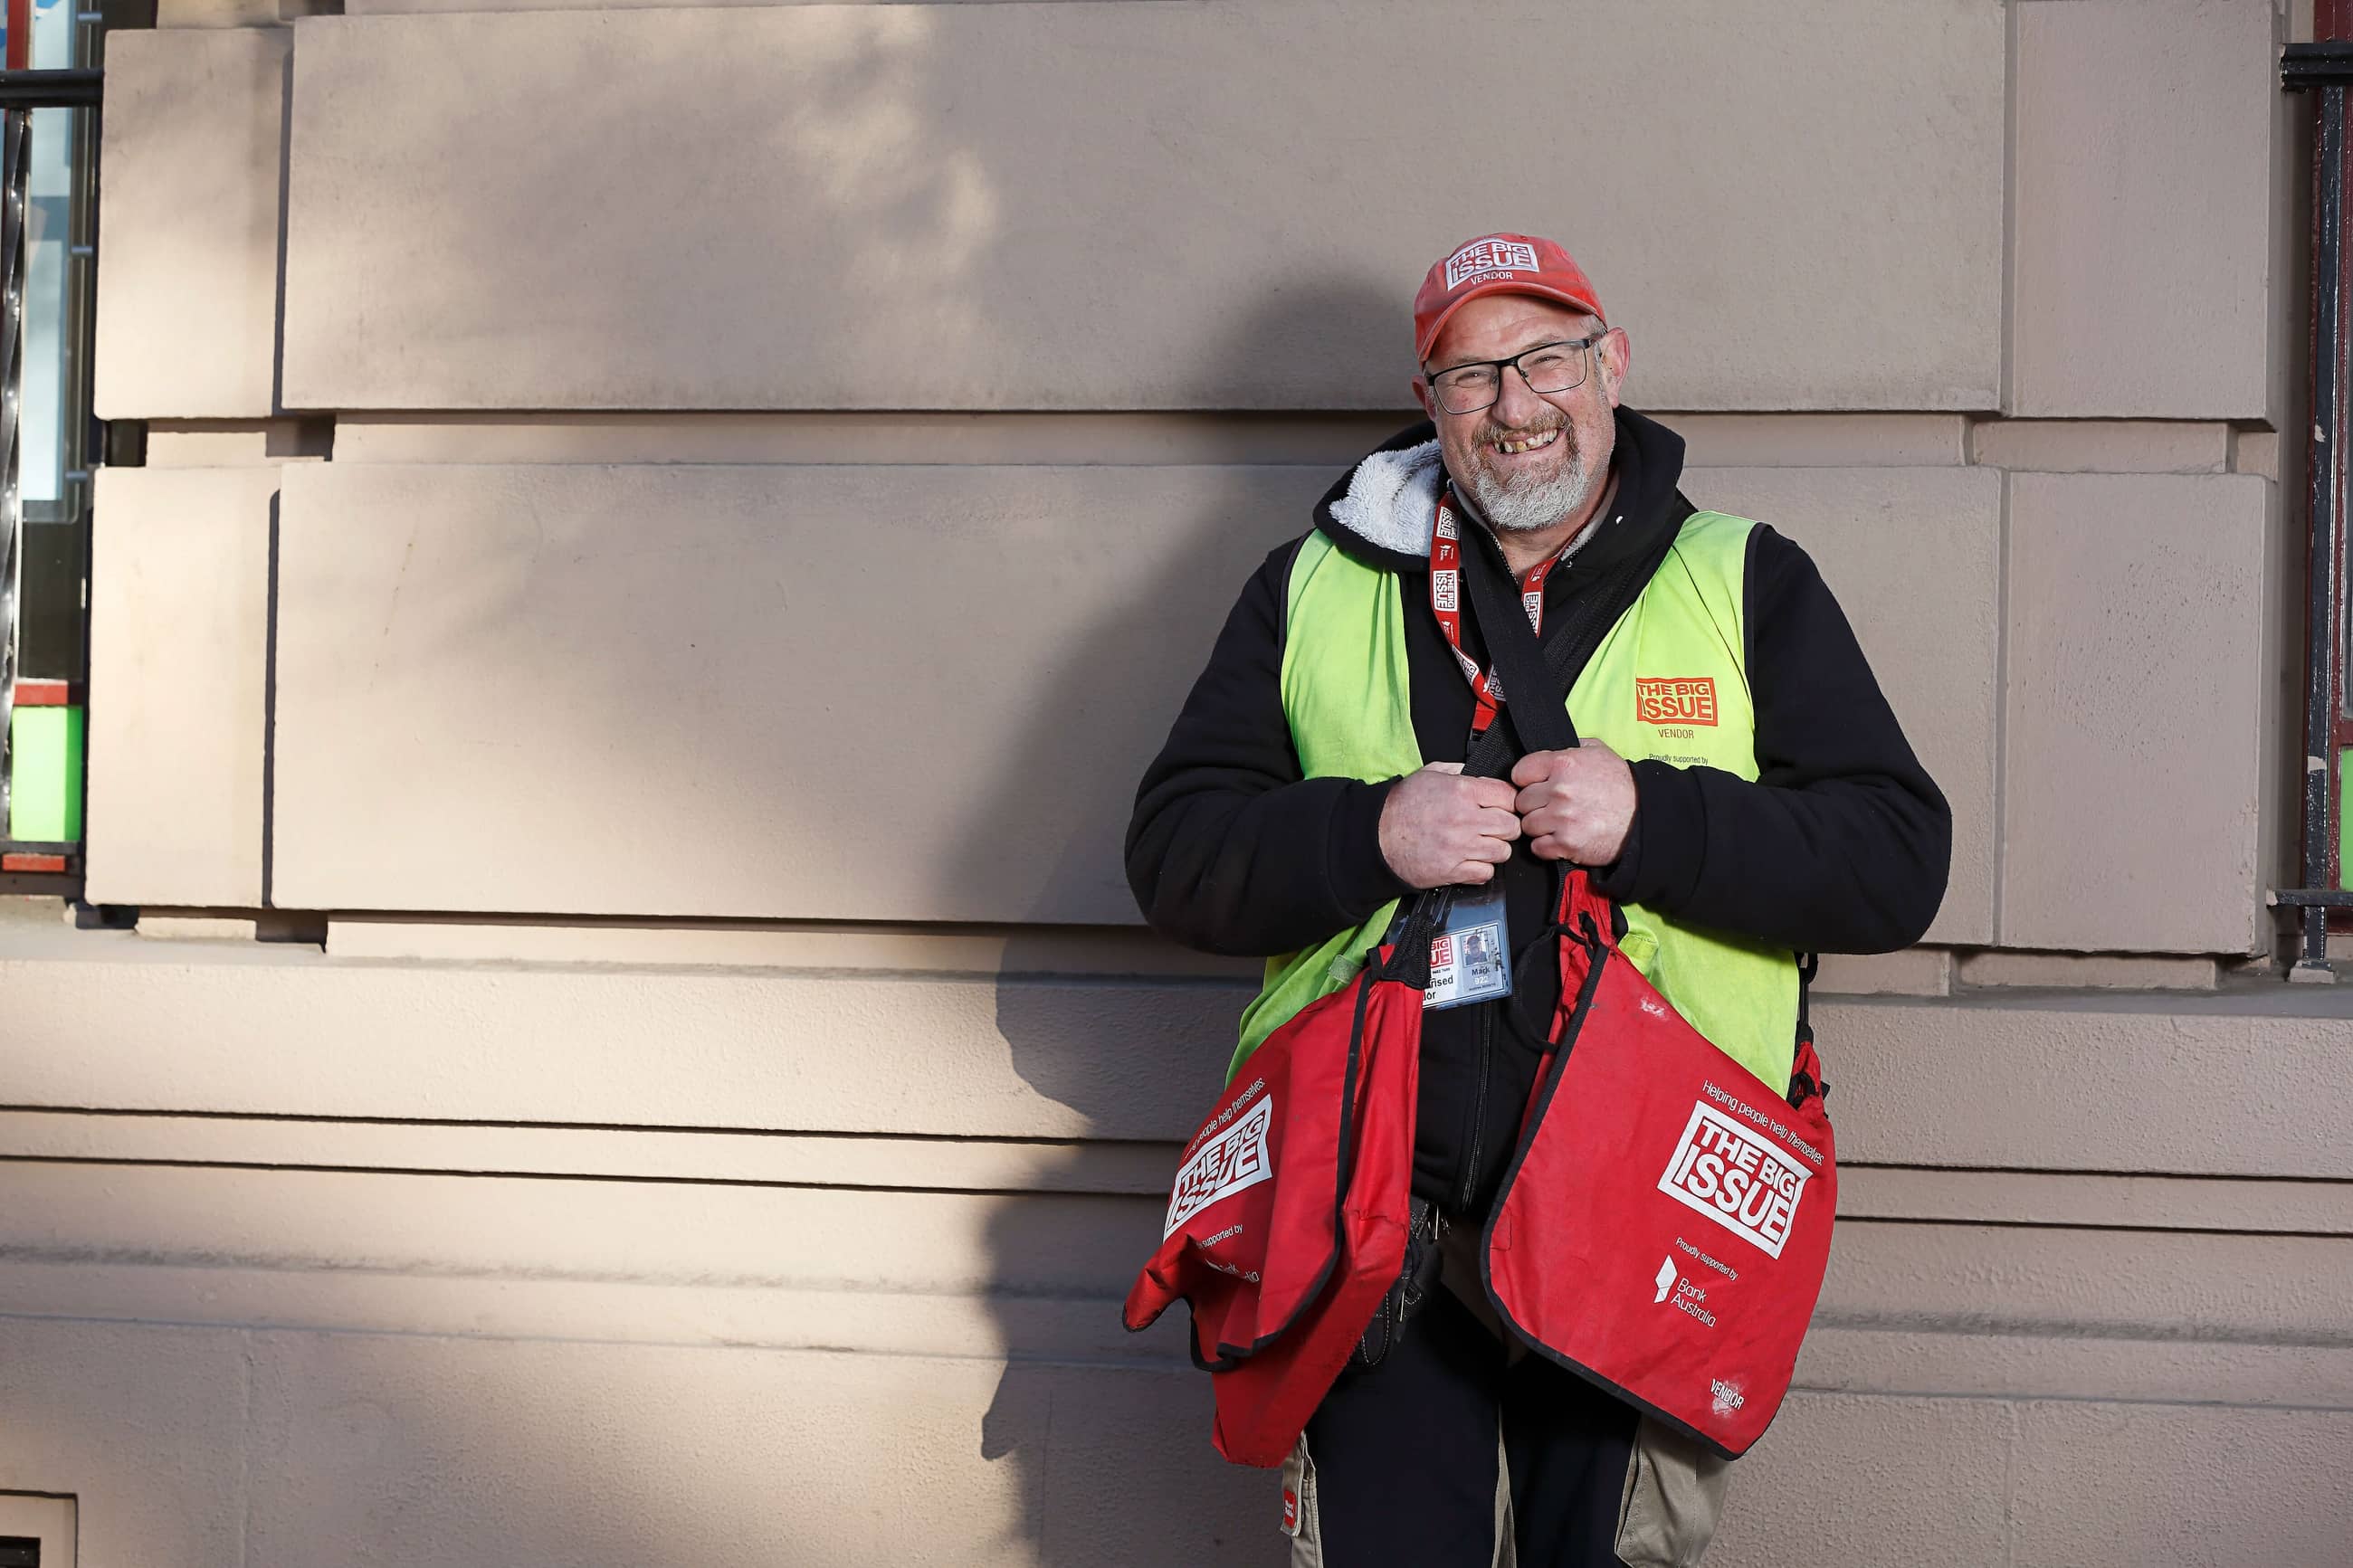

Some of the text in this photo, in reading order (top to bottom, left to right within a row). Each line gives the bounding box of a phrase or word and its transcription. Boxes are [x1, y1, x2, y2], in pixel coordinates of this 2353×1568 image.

[1451, 242, 1529, 266] THE BIG
[1452, 252, 1532, 283] ISSUE
[1470, 271, 1514, 285] VENDOR
[1440, 508, 1453, 537] ISSUE
[1436, 573, 1448, 608] ISSUE
[1637, 683, 1710, 697] THE BIG
[1657, 727, 1695, 740] VENDOR
[1672, 755, 1700, 765] supported
[1700, 755, 1709, 765] by
[1217, 1107, 1233, 1126] help
[1231, 1077, 1266, 1114] themselves.
[1701, 1079, 1824, 1166] Helping people help themselves.
[1180, 1145, 1223, 1193] THE
[1224, 1115, 1264, 1160] BIG
[1700, 1118, 1798, 1200] THE BIG
[1167, 1134, 1261, 1229] ISSUE
[1674, 1143, 1792, 1242] ISSUE
[1201, 1225, 1234, 1249] supported
[1234, 1223, 1243, 1234] by
[1675, 1236, 1739, 1281] Proudly supported by
[1676, 1277, 1708, 1304] Bank
[1670, 1292, 1718, 1328] Australia
[1710, 1378, 1745, 1411] VENDOR
